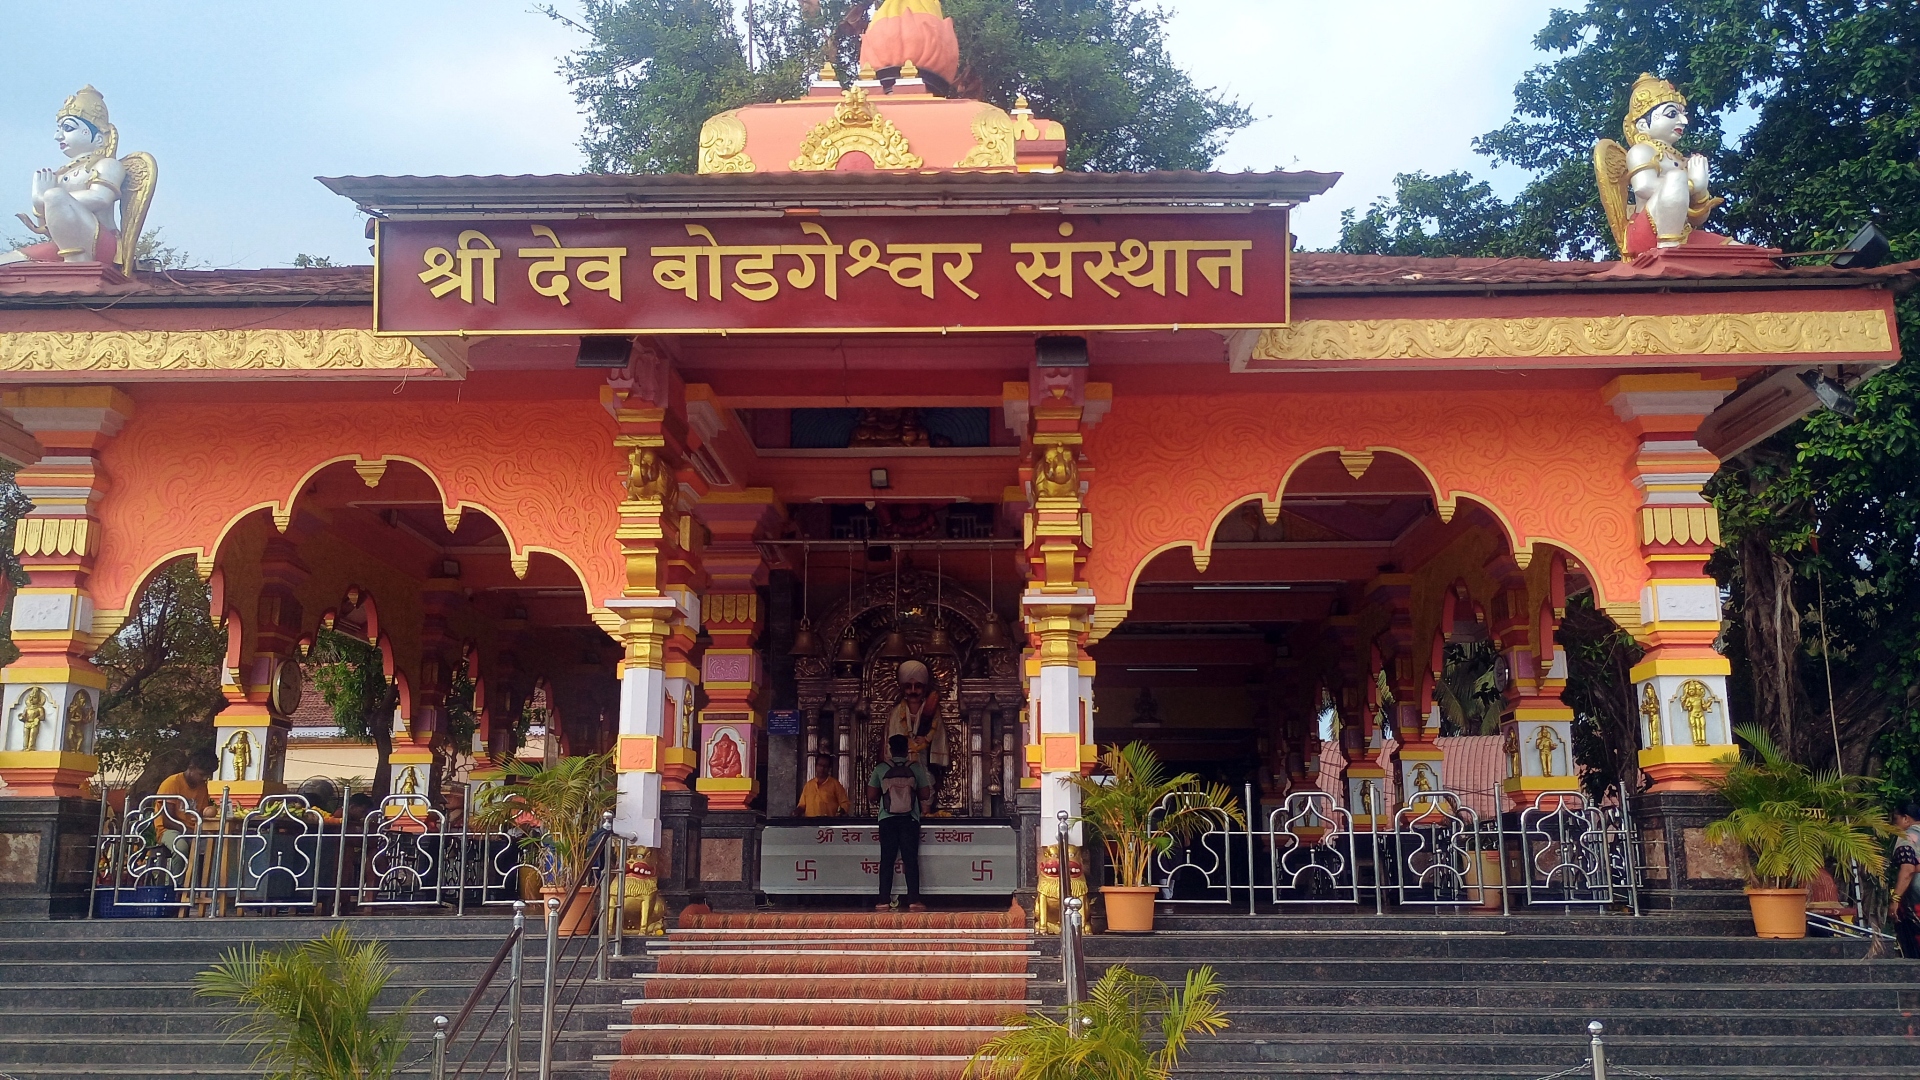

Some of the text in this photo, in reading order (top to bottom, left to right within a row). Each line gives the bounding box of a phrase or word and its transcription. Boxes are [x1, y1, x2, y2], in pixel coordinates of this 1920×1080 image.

[418, 221, 1252, 306] श्री देव बोडगेश्वर संस्थान
[815, 828, 835, 844] श्री
[841, 828, 863, 845] देव
[934, 828, 975, 844] संस्थान
